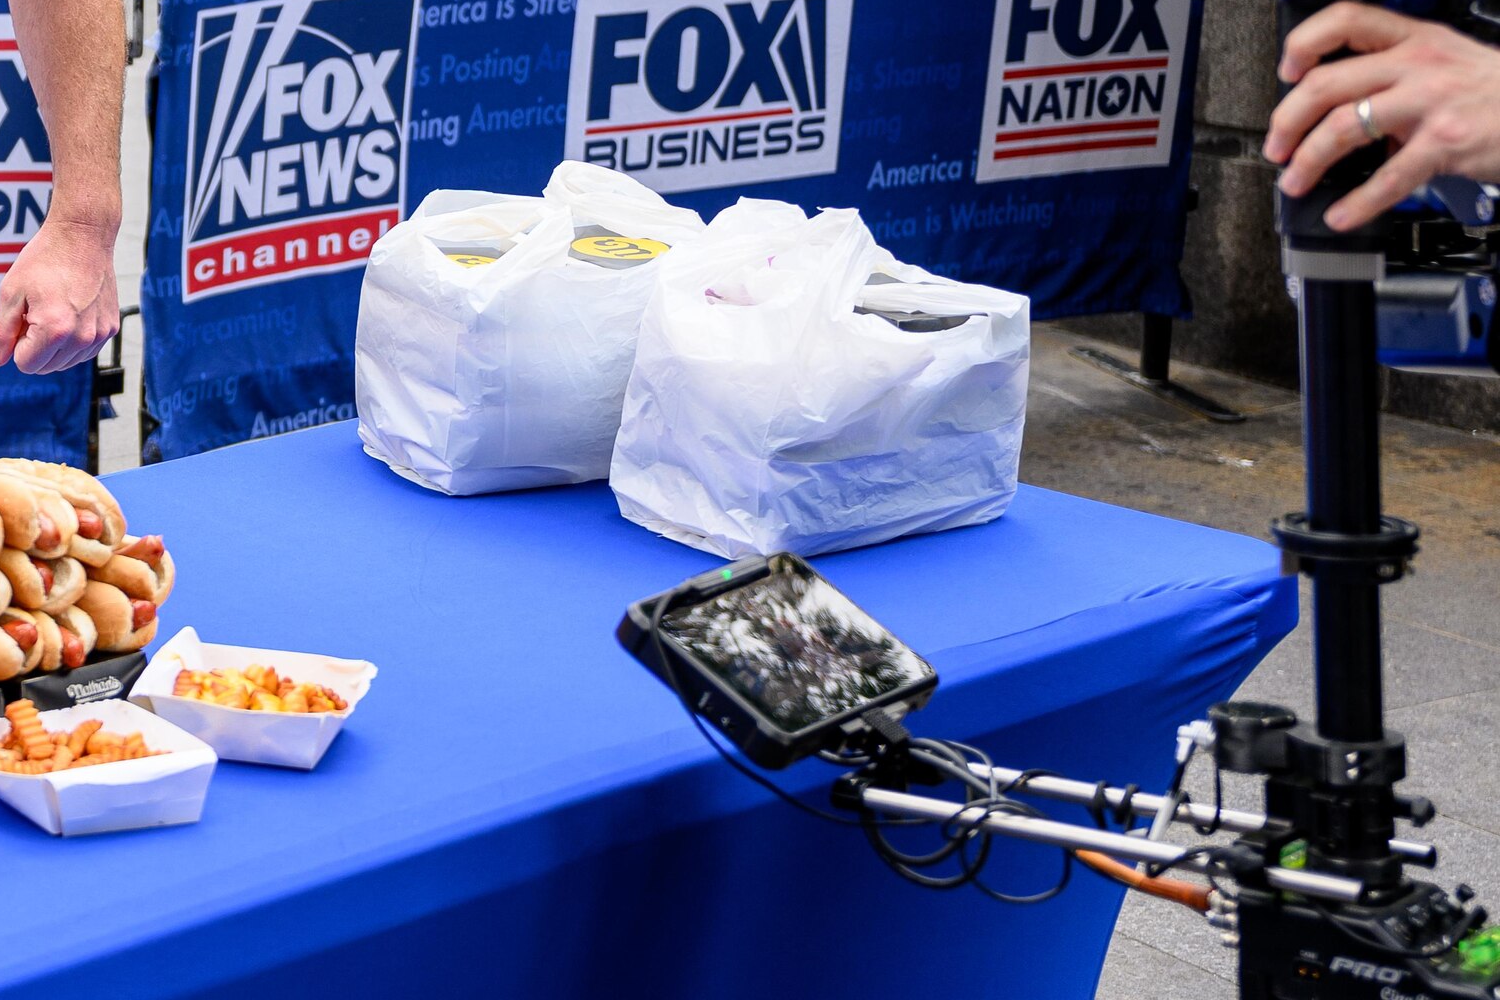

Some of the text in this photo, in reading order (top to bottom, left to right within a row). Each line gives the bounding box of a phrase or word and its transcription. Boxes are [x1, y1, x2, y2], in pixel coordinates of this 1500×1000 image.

[439, 47, 532, 86] Posting
[263, 49, 401, 142] FOX
[998, 72, 1166, 126] NATION
[584, 116, 826, 172] BUSINESS
[218, 129, 397, 227] NEWS
[866, 153, 964, 192] America
[925, 206, 942, 236] is
[950, 193, 1054, 233] Watching
[193, 219, 390, 282] channel
[1329, 955, 1403, 984] PRO
